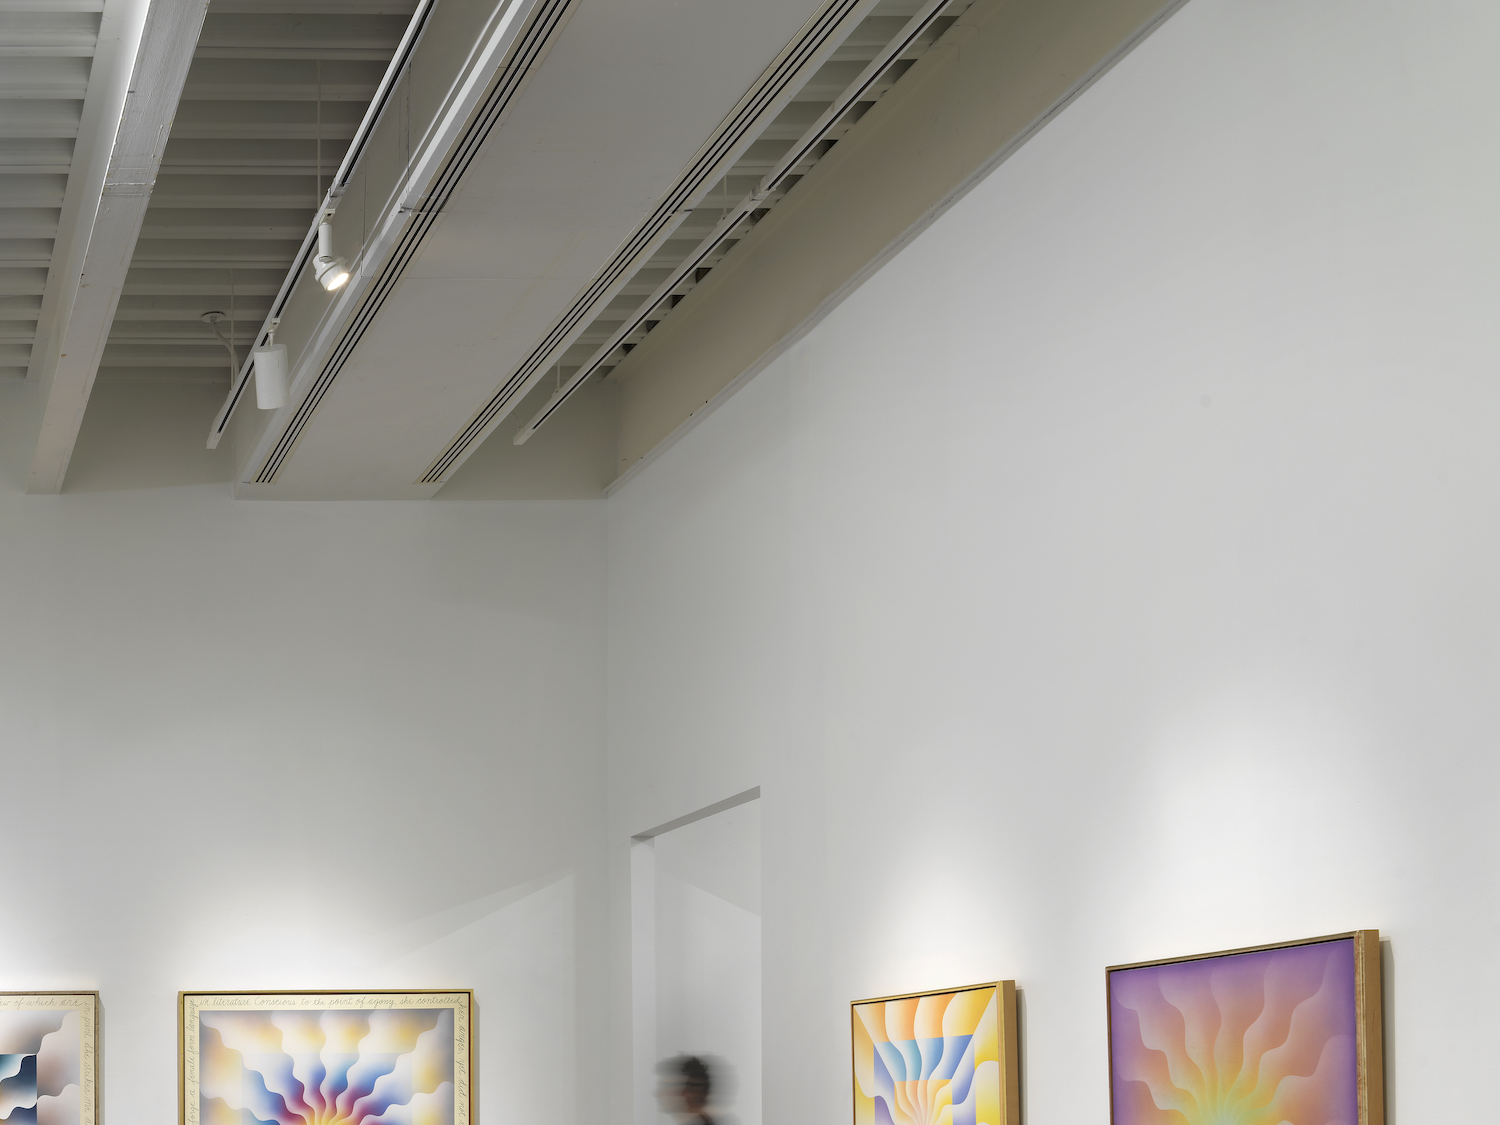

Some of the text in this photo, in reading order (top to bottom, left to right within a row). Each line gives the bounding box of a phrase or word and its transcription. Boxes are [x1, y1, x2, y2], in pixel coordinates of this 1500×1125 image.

[13, 997, 25, 1010] of
[26, 997, 58, 1007] which
[59, 998, 83, 1007] are
[84, 1002, 91, 1014] in
[254, 996, 296, 1006] Conscious
[312, 997, 325, 1005] the
[328, 998, 353, 1008] point
[355, 996, 366, 1008] of
[399, 996, 414, 1005] she
[416, 996, 463, 1005] controlled
[186, 999, 198, 1034] language
[458, 1002, 467, 1022] her
[84, 1042, 93, 1059] She
[187, 1035, 199, 1055] form
[187, 1056, 199, 1084] female
[455, 1058, 466, 1075] yet
[84, 1061, 93, 1095] strikes
[189, 1089, 195, 1098] a
[458, 1077, 467, 1098] did
[84, 1097, 92, 1113] me
[187, 1101, 199, 1125] forge
